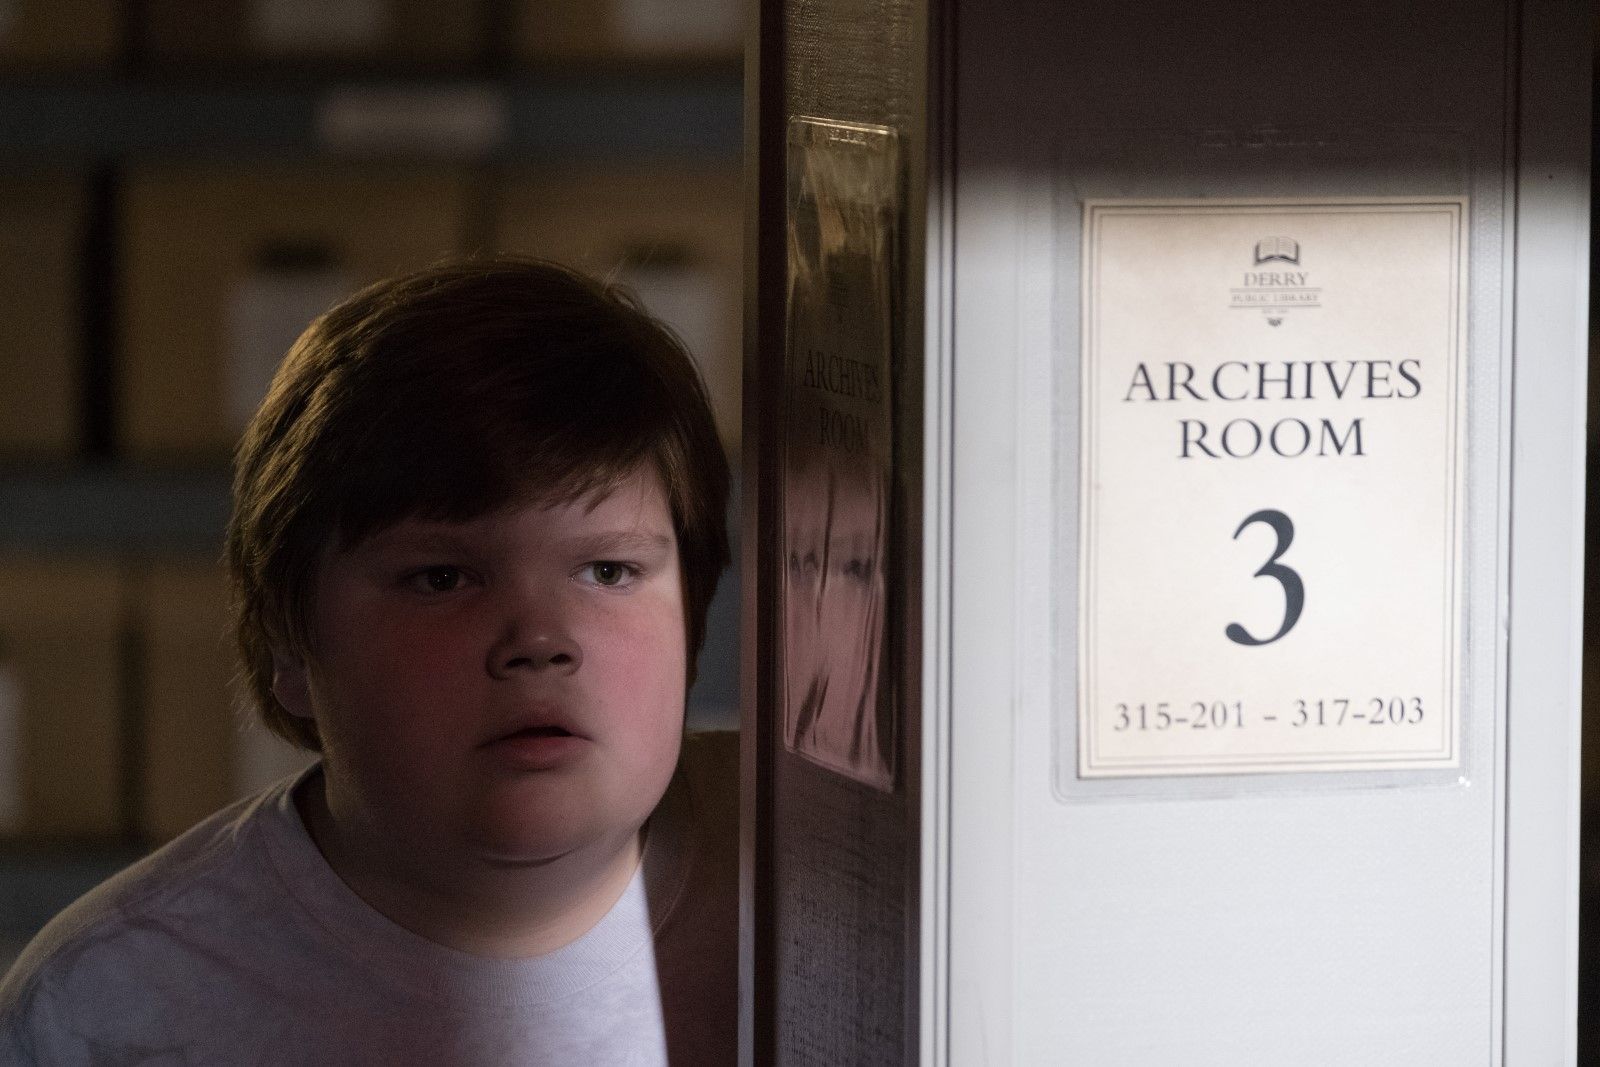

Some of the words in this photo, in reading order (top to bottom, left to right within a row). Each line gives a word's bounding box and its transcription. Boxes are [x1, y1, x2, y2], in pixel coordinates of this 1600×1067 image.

[1244, 272, 1309, 287] DERRY
[1124, 359, 1422, 402] ARCHIVES
[1178, 418, 1367, 459] ROOM
[1225, 508, 1305, 646] 3
[1113, 701, 1246, 731] 315-201
[1292, 697, 1425, 728] 317-203
